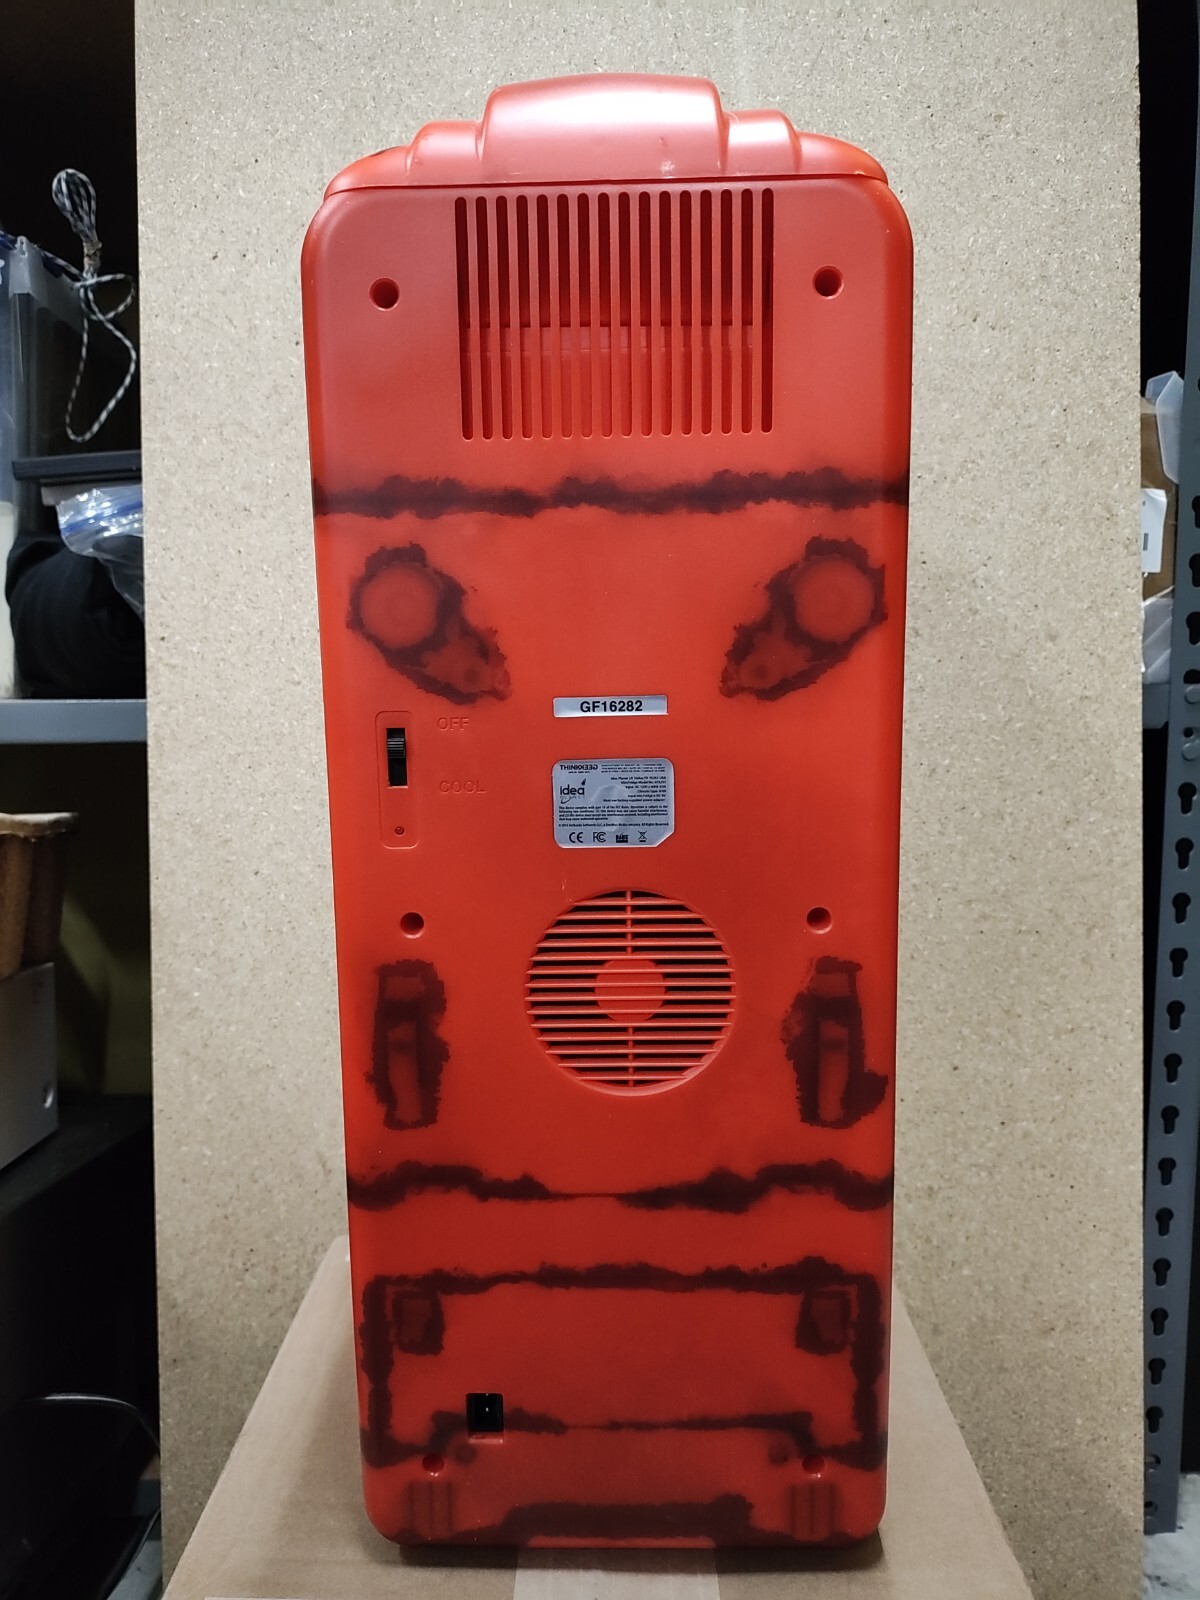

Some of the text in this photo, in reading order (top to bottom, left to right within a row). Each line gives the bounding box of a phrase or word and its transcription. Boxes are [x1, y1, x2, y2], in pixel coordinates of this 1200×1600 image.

[580, 700, 643, 712] GF16282
[436, 716, 469, 731] OFF
[439, 780, 487, 794] COOL
[560, 784, 585, 795] idea
[568, 832, 584, 843] CE
